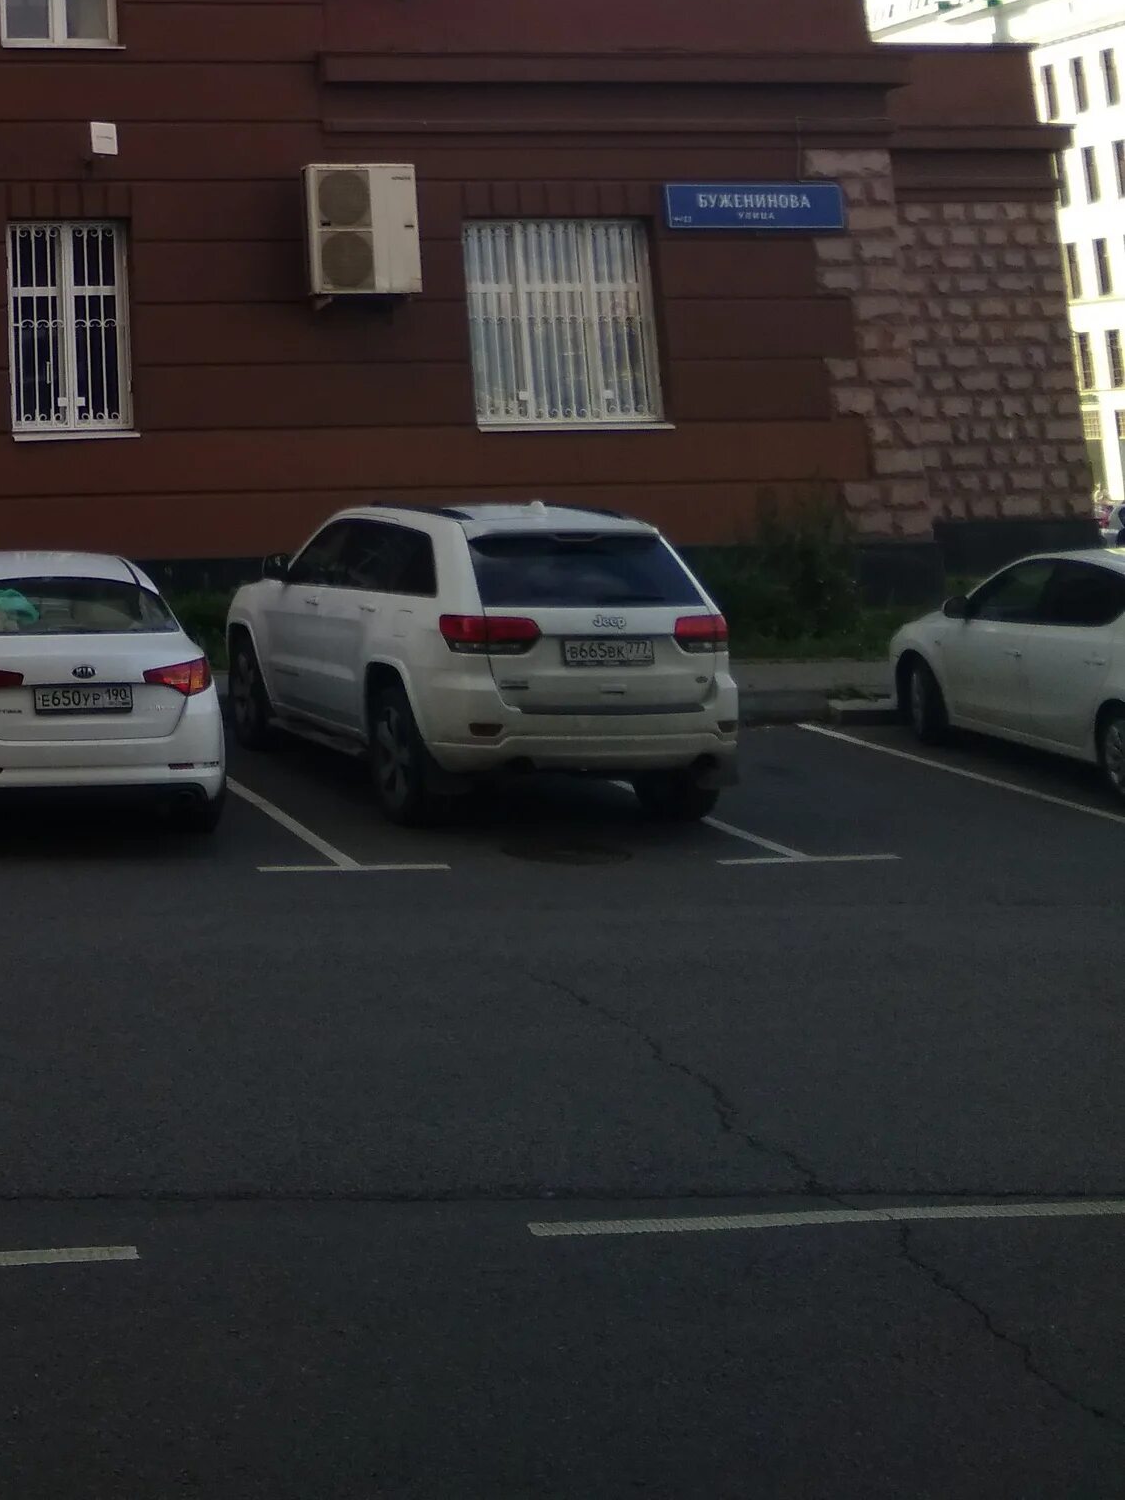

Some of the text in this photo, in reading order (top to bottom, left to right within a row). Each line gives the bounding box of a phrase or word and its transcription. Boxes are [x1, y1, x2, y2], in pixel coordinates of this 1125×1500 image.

[697, 193, 811, 209] БУЖЕНИНОВА
[738, 212, 775, 220] УЛИЦА
[593, 615, 626, 629] Jeep
[75, 668, 94, 678] KIA
[106, 688, 126, 701] 190
